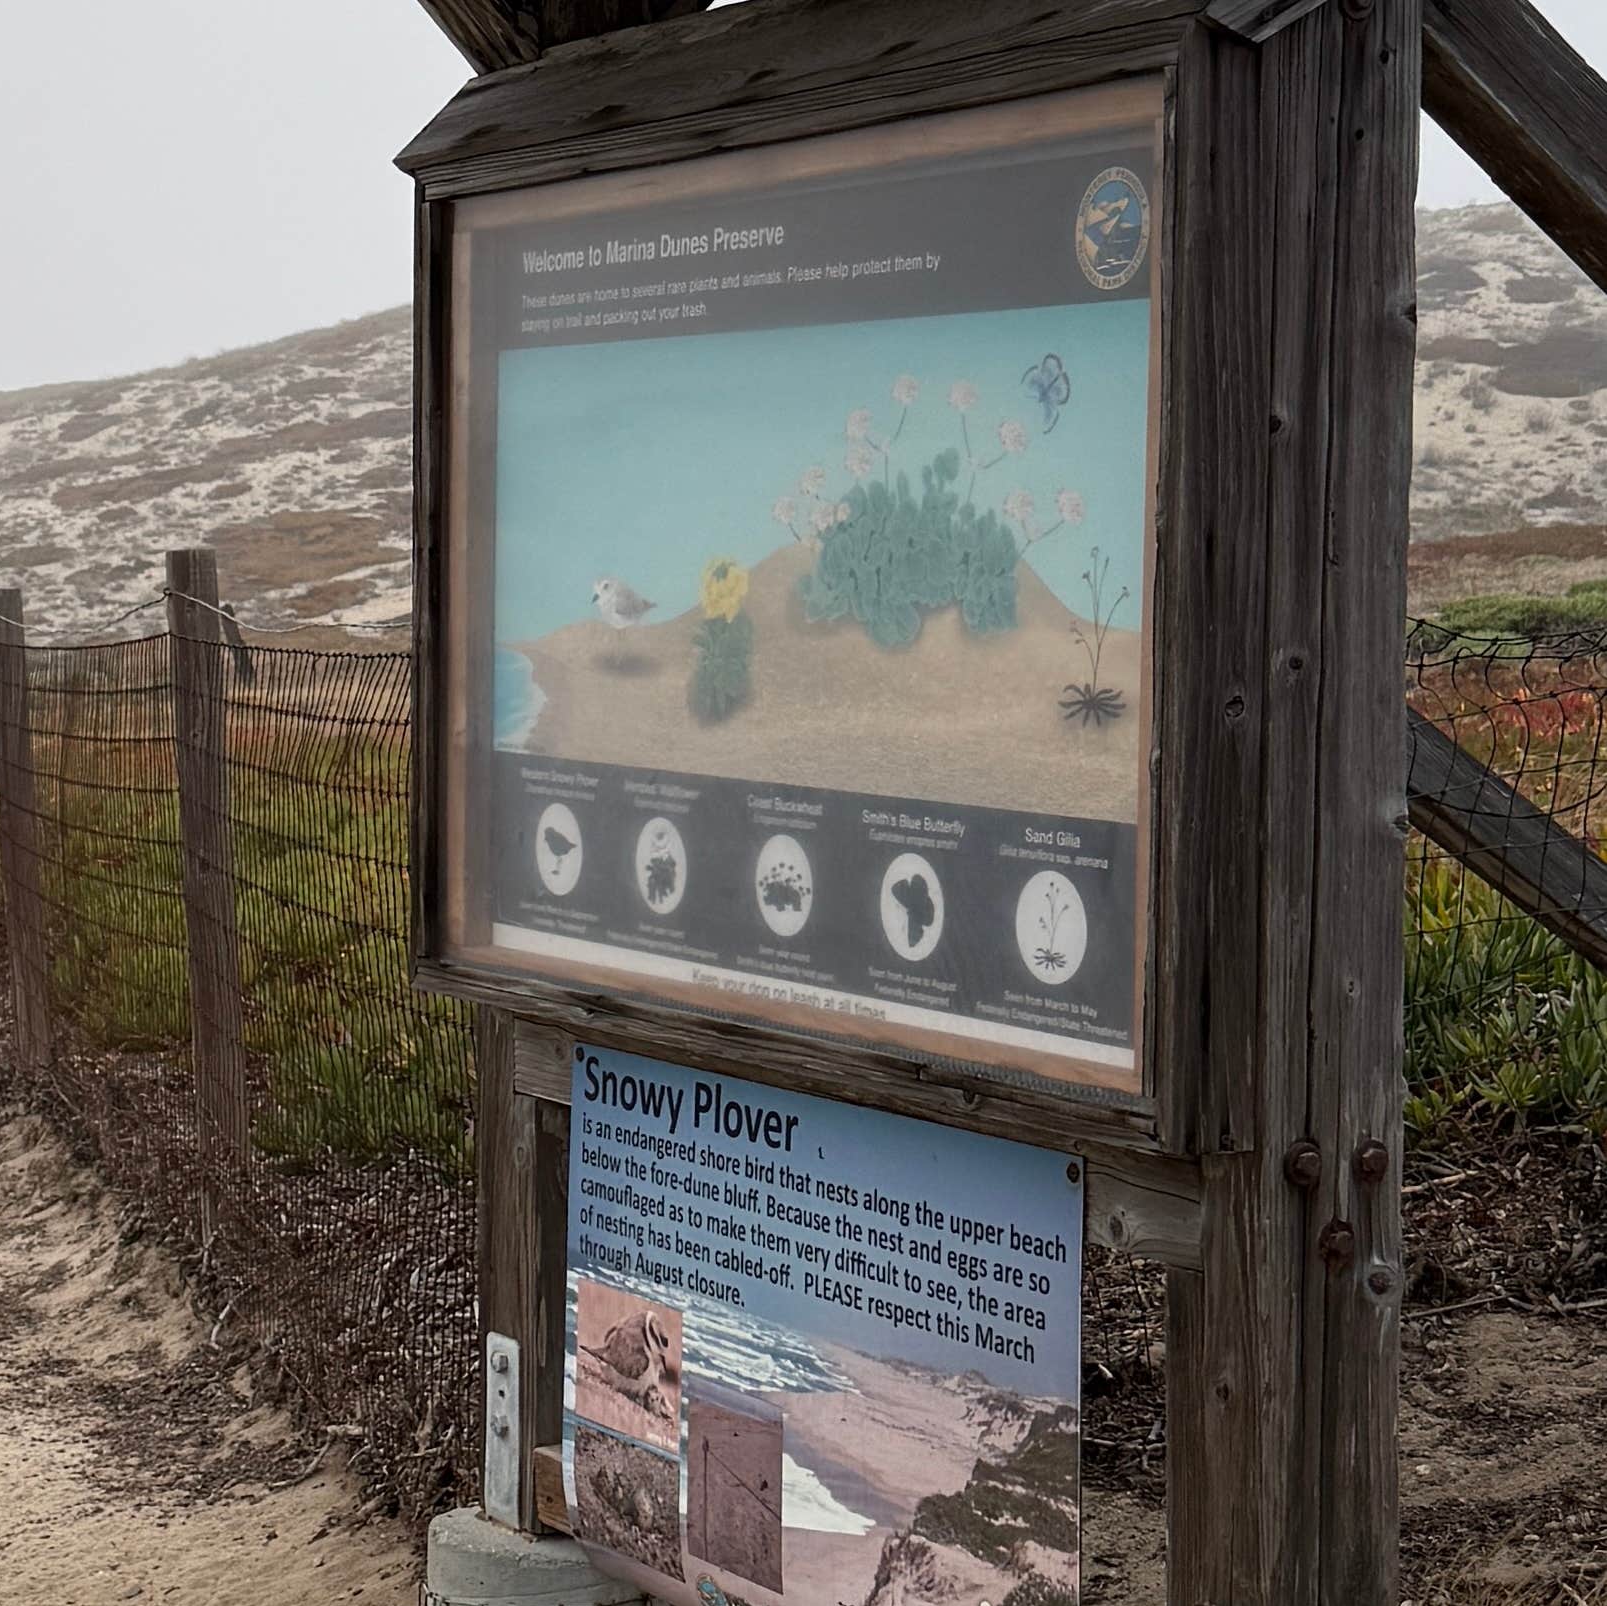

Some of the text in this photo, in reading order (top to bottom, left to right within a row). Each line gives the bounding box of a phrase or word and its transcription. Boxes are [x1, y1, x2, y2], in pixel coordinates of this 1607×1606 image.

[523, 225, 785, 273] Welcome to Marina Dunes Preserve
[621, 285, 629, 298] to
[632, 280, 666, 297] several
[667, 281, 687, 294] rare
[689, 275, 718, 293] plants
[721, 272, 740, 288] and
[788, 265, 822, 282] Please
[826, 262, 848, 280] help
[852, 256, 891, 279] protect
[895, 254, 922, 272] them
[926, 252, 940, 271] by
[553, 317, 564, 329] on
[584, 311, 601, 326] and
[603, 309, 638, 326] packing
[641, 306, 656, 320] out
[659, 306, 680, 322] your
[862, 809, 966, 837] Smith's Blue Butterfly
[1026, 827, 1053, 845] Sand
[584, 1056, 799, 1151] Snowy Plover
[582, 1112, 1067, 1263] is an endangered shore bird that nests along the upper beach
[582, 1143, 1050, 1295] below the fore-dune bluff. Because the nest and eggs are so
[579, 1235, 745, 1307] through August closure.
[580, 1205, 1035, 1364] of nesting has been cabled-off. PLEASE respect this March
[581, 1177, 1046, 1330] camouflaged as to make them very difficult to see, the area
